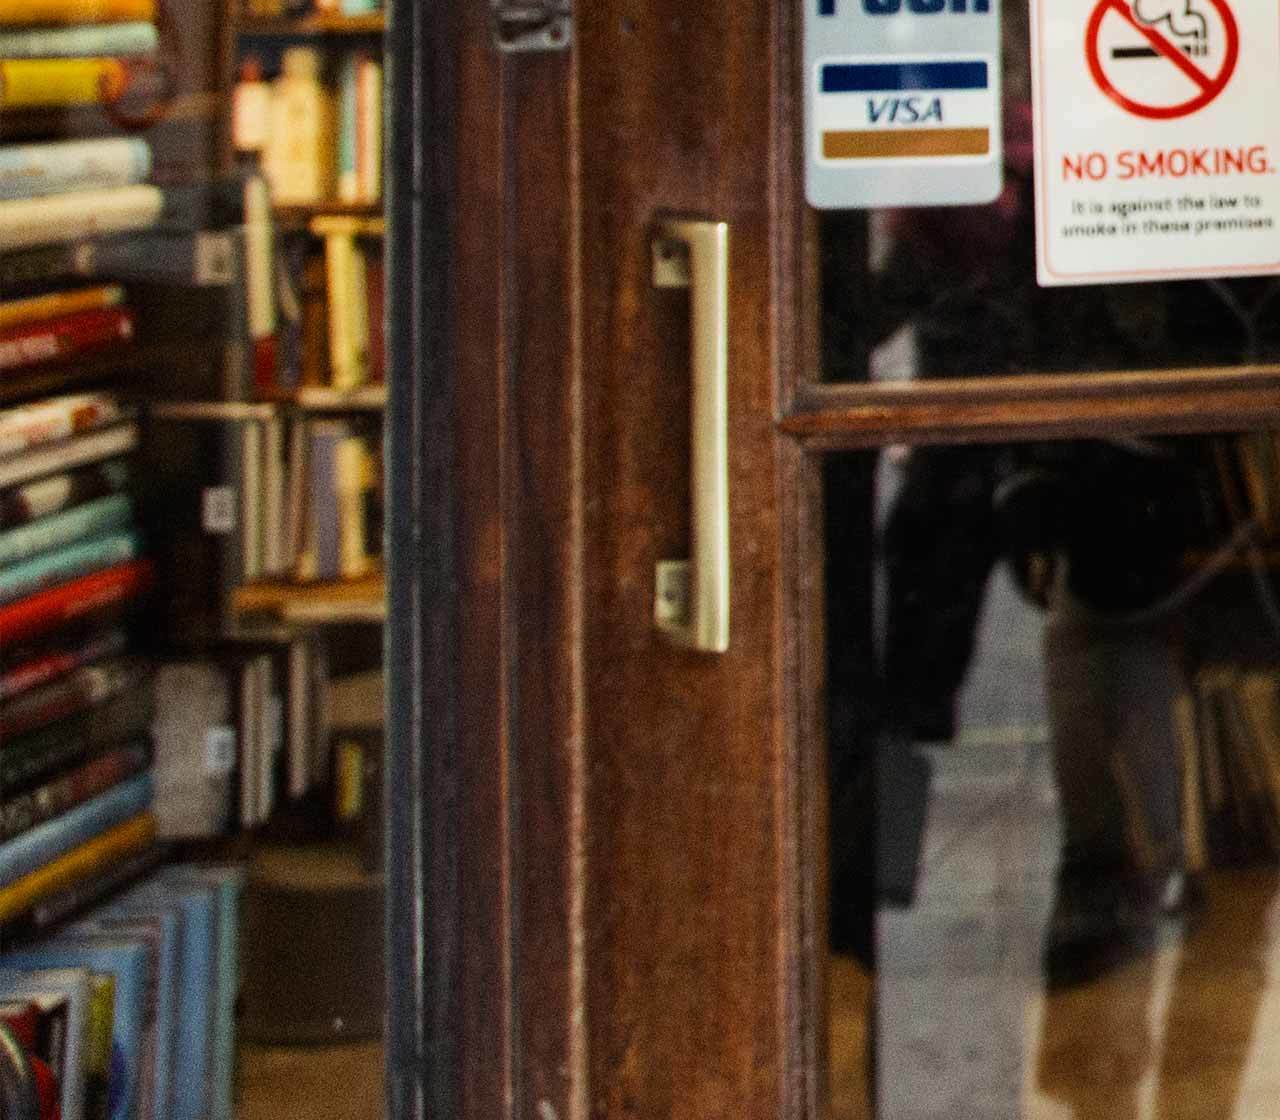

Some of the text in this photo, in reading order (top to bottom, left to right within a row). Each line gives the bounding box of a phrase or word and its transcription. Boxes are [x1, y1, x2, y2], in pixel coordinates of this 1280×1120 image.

[865, 96, 944, 125] VISA
[1062, 144, 1277, 181] NO SMOKING.
[1110, 194, 1172, 218] against
[1177, 193, 1206, 211] the
[1210, 192, 1239, 210] law
[1243, 192, 1262, 208] to
[1062, 216, 1274, 238] smoke in these premises
